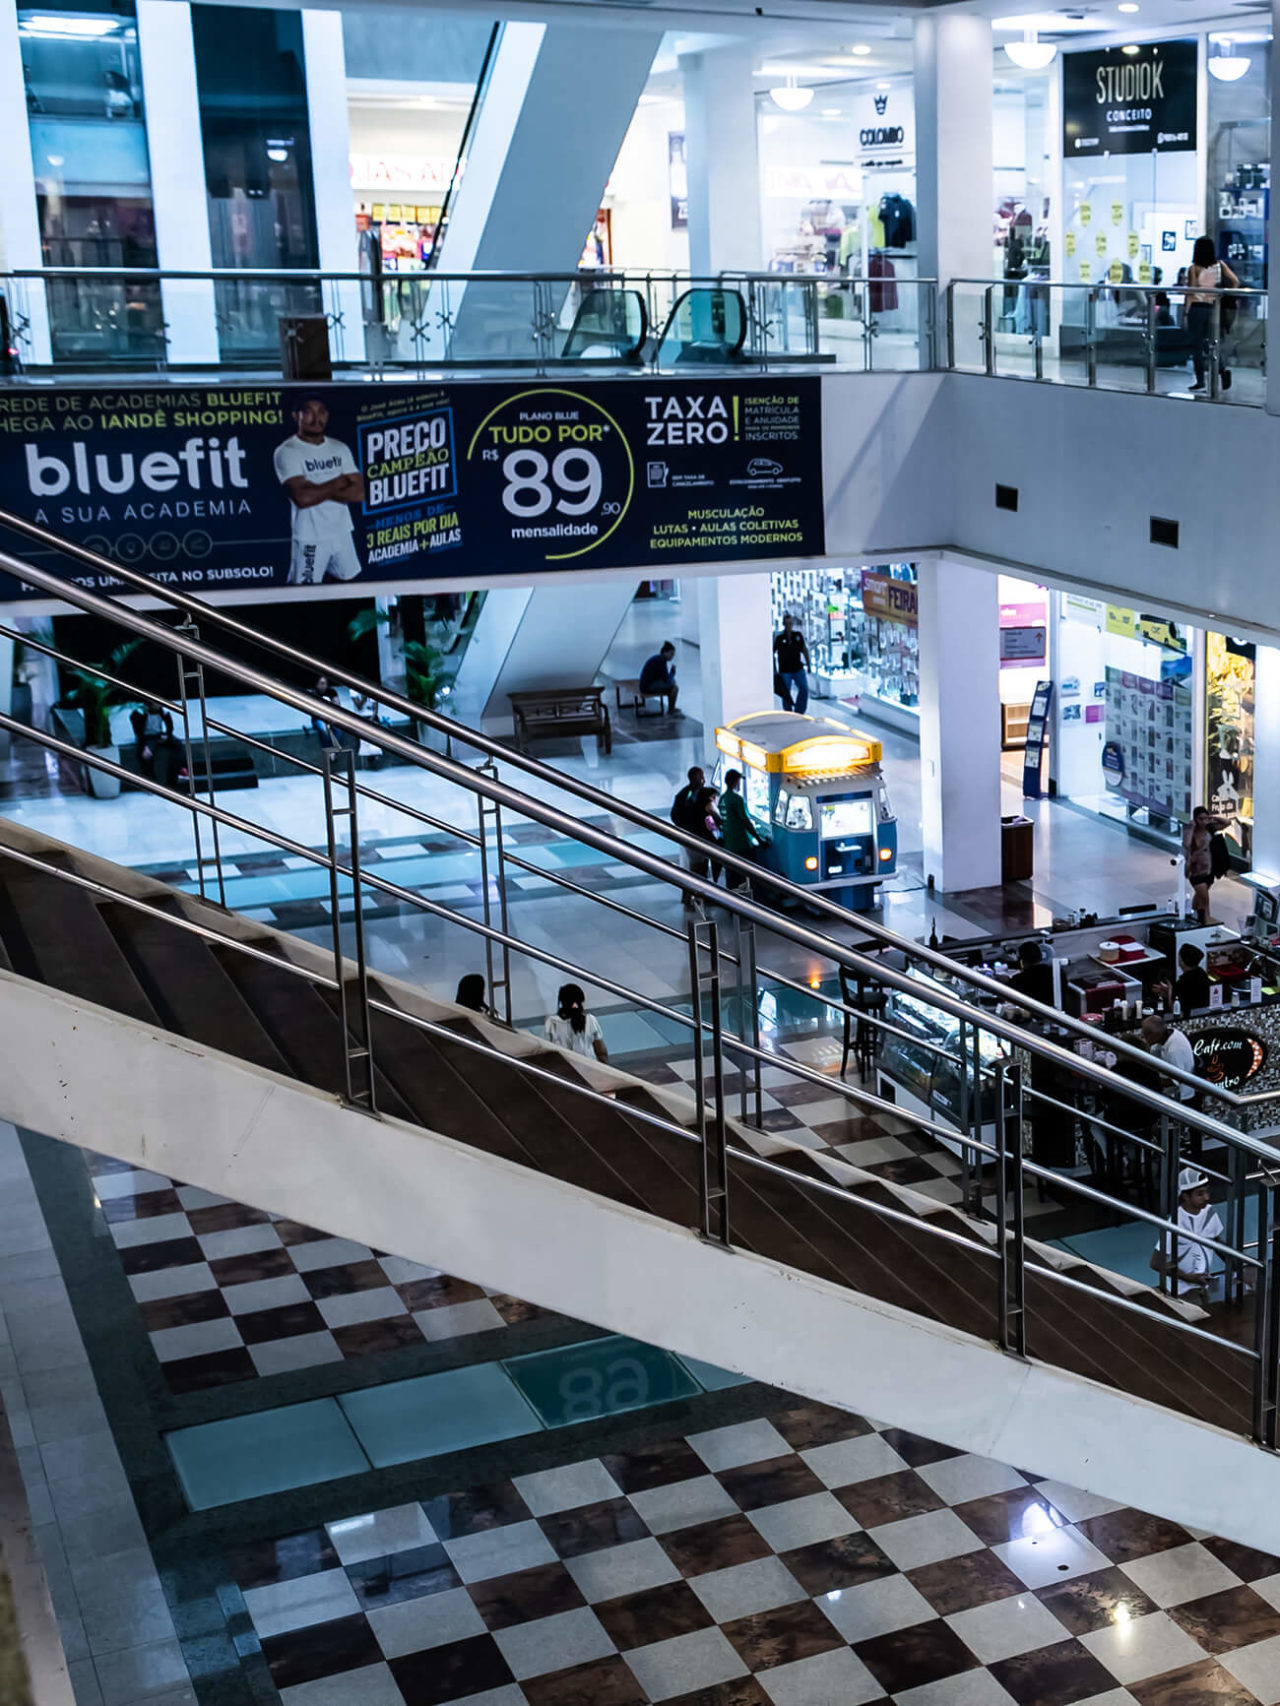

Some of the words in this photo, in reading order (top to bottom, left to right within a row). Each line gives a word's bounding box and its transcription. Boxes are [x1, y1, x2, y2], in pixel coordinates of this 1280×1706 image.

[1106, 108, 1152, 122] CONCEITO
[56, 396, 83, 411] DE
[89, 392, 201, 410] ACADEMIAS
[207, 391, 282, 406] BLUEFIT
[645, 396, 728, 419] TAXA
[787, 396, 799, 404] DE
[63, 415, 94, 430] AO
[101, 409, 166, 429] IANDÊ
[174, 410, 283, 426] SHOPPING!
[367, 417, 446, 464] PREÇO
[489, 426, 551, 443] TUDO
[25, 436, 248, 496] bluefit
[367, 448, 449, 478] CAMPEÃO
[369, 463, 449, 506] BLUEFIT
[482, 450, 499, 461] R$
[502, 448, 603, 518] 89
[34, 509, 49, 524] A
[62, 505, 111, 523] SUA
[124, 499, 251, 520] ACADEMIA
[688, 505, 765, 520] MUSCULAÇÃO
[367, 533, 374, 548] 3
[377, 524, 411, 546] REAIS
[413, 517, 437, 536] POR
[440, 512, 459, 529] DIA
[511, 522, 598, 538] mensalidade
[653, 524, 689, 535] LUTAS
[700, 522, 737, 533] AULAS
[739, 519, 799, 531] COLETIVAS
[368, 539, 419, 564] ACADEMIA
[430, 528, 462, 549] AULAS
[650, 535, 738, 549] EQUIPAMENTOS
[740, 531, 803, 544] MODERNOS
[182, 570, 203, 581] NO
[207, 566, 274, 580] SUBSOLO!
